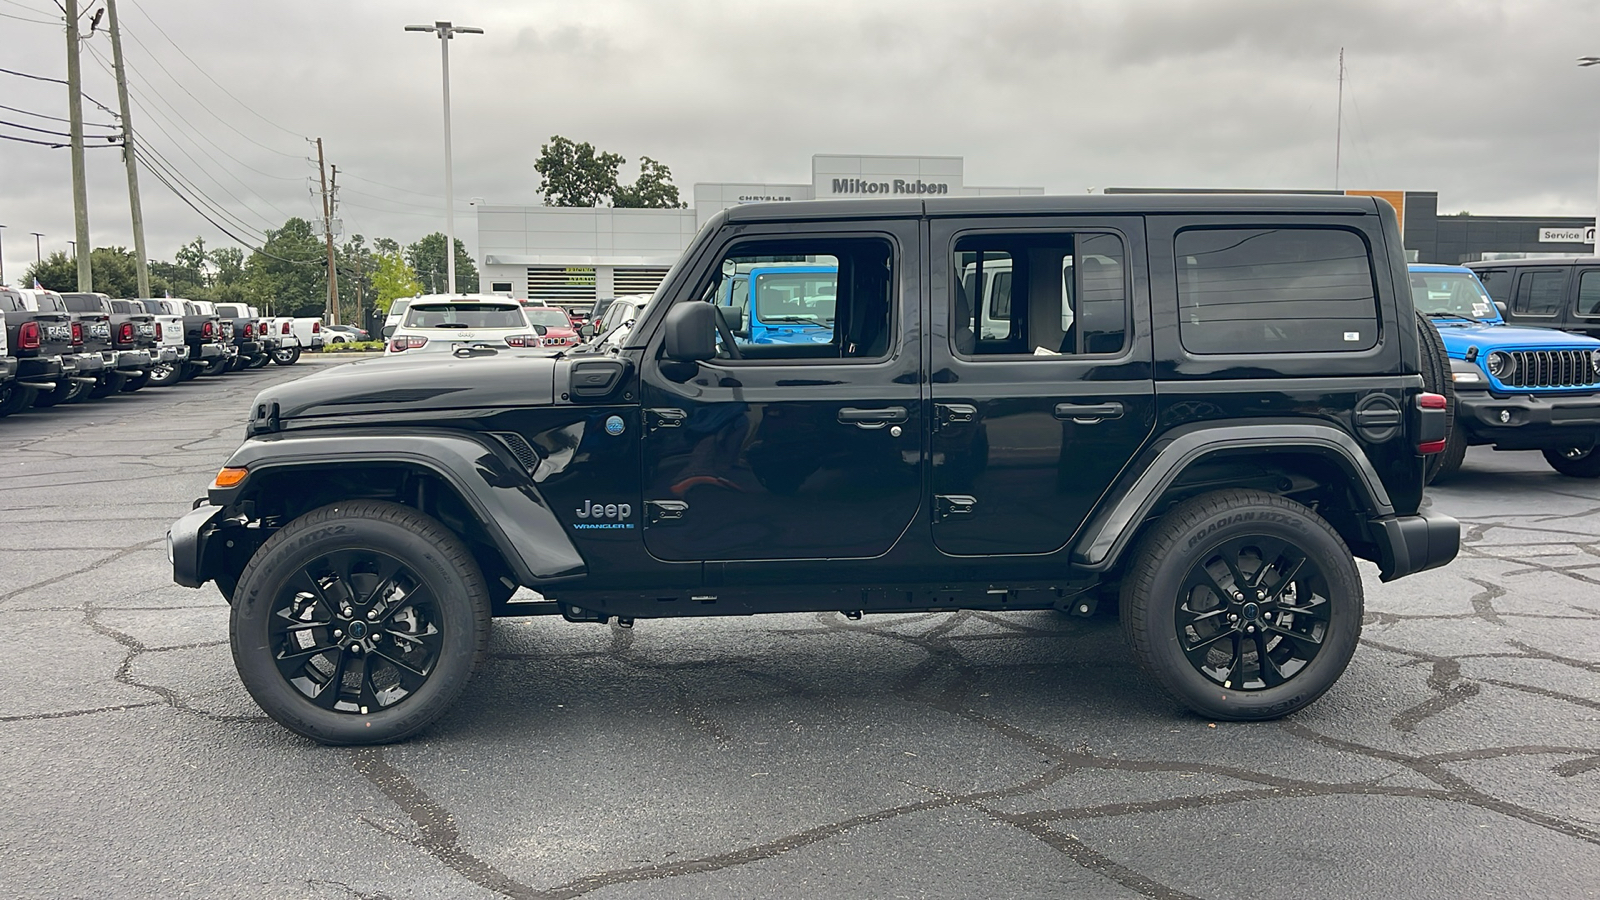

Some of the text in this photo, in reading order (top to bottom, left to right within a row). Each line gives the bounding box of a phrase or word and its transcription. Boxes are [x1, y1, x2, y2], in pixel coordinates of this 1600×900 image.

[832, 178, 948, 195] Milton Ruben
[1544, 231, 1580, 239] Service
[575, 499, 632, 521] Jeep
[1187, 511, 1255, 549] ROADIAN
